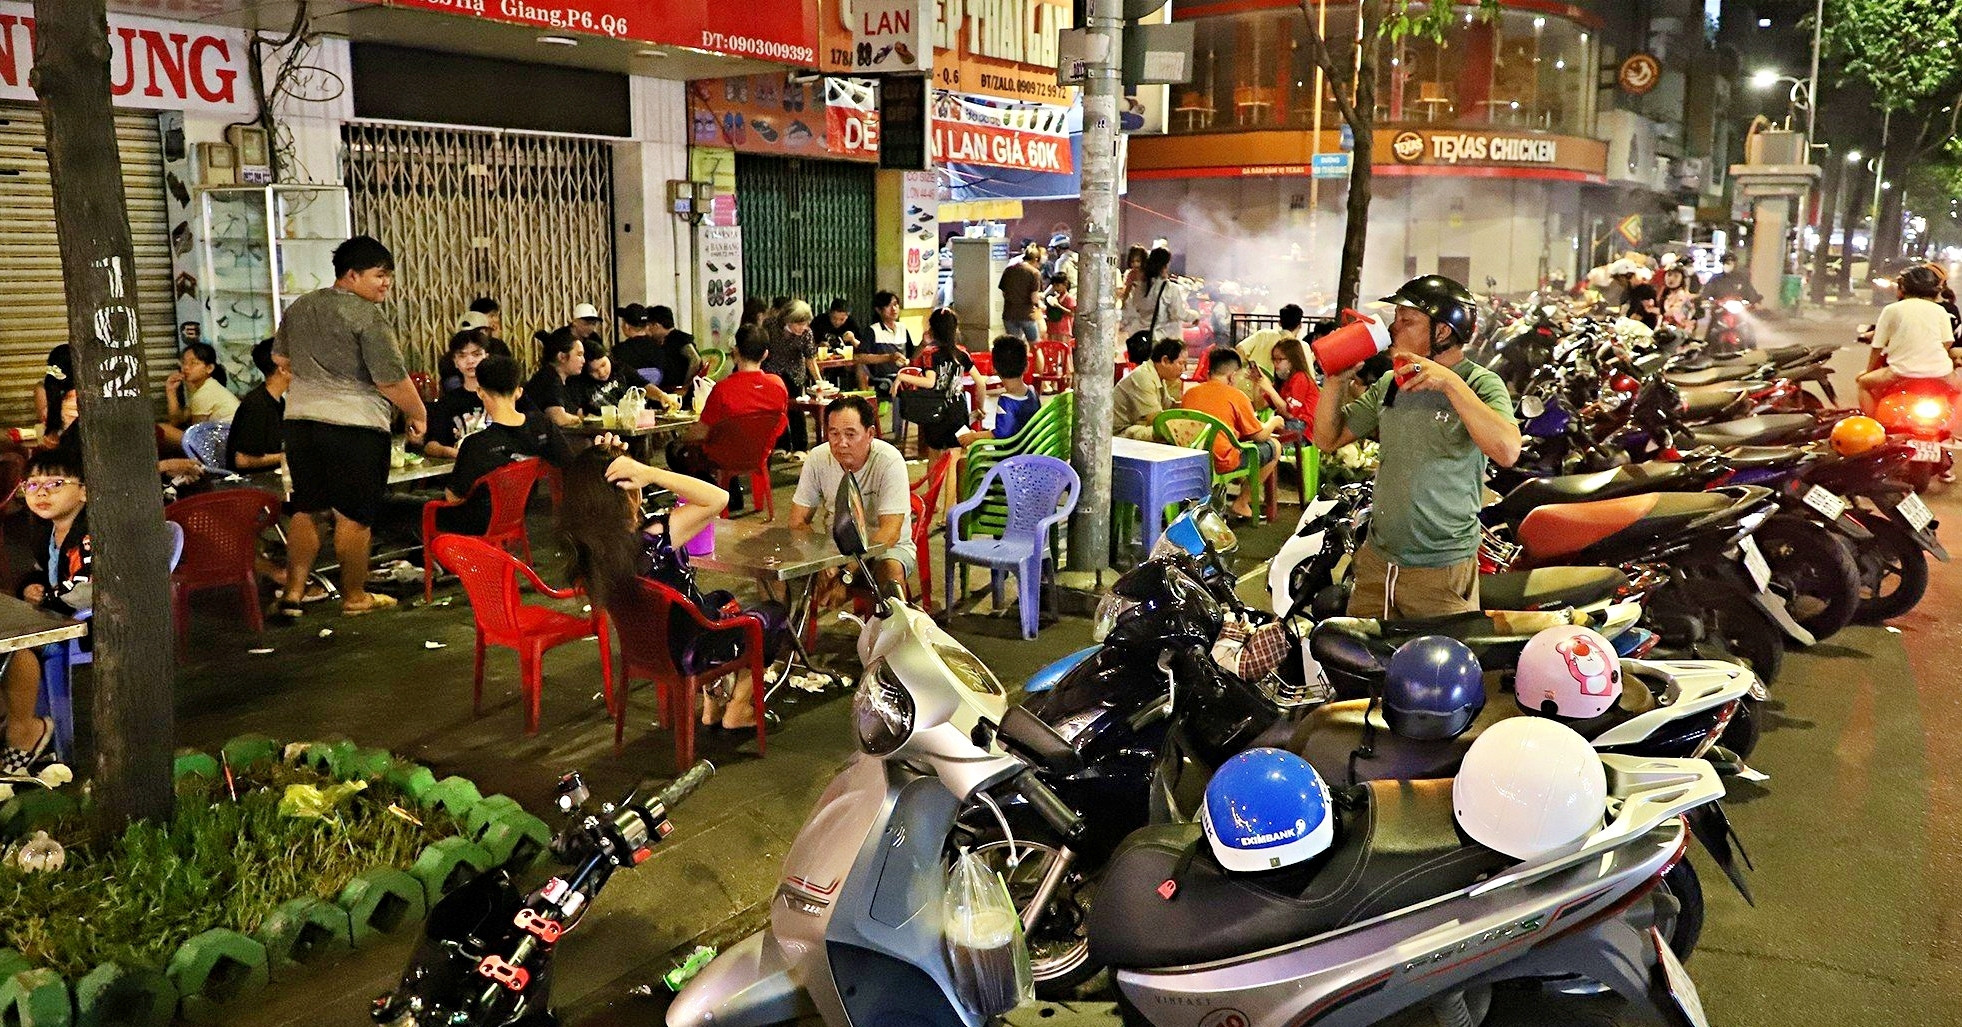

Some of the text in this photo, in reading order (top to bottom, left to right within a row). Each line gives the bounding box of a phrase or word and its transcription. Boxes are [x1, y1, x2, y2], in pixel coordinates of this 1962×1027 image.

[864, 9, 910, 35] LAN
[702, 30, 813, 62] ĐT:0903009392
[953, 69, 959, 84] 6
[1037, 83, 1046, 96] 72
[948, 130, 988, 161] LAN
[992, 132, 1025, 166] GIÁ
[1027, 139, 1060, 169] 60K
[1394, 137, 1424, 156] TEXAS
[1431, 134, 1556, 163] TEXAS CHICKEN
